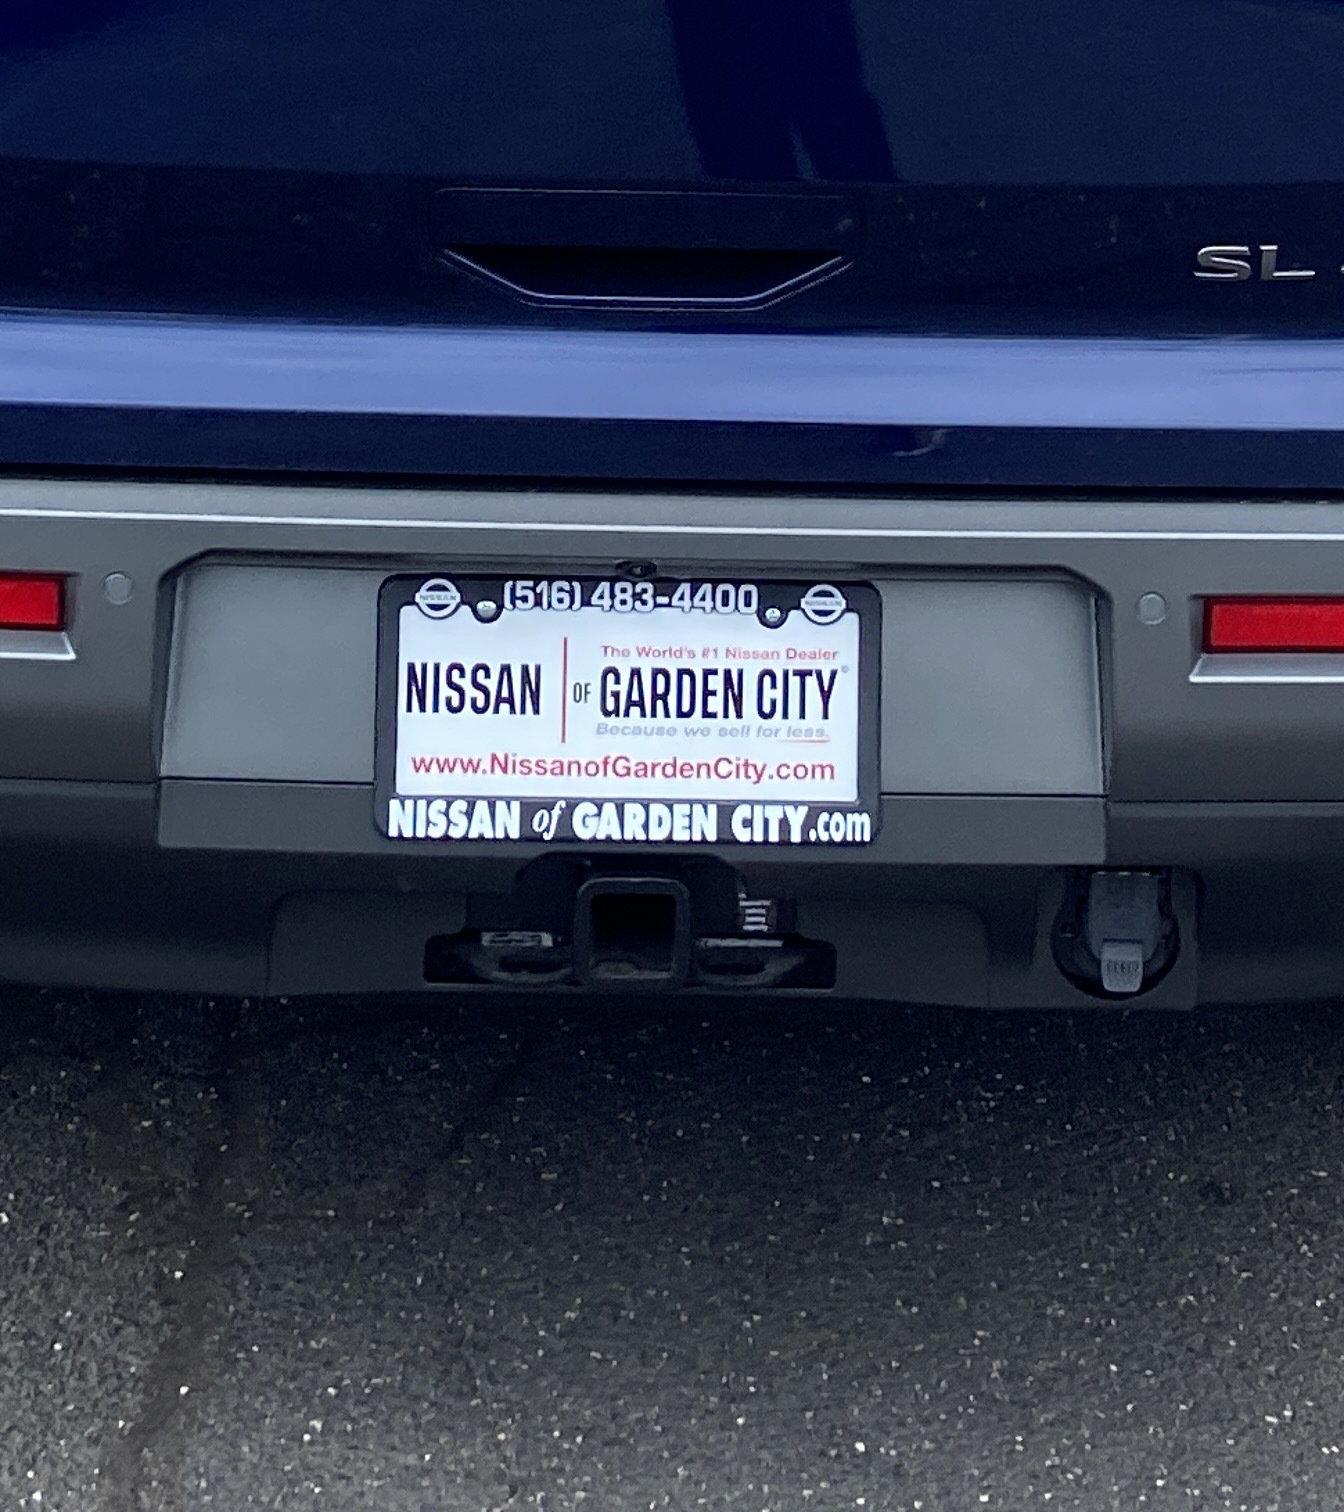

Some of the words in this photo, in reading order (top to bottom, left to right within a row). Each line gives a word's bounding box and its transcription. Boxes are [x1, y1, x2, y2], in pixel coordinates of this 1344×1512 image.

[1193, 245, 1316, 281] SL
[504, 580, 582, 611] (516)
[591, 581, 759, 616] 483-4400
[600, 644, 631, 658] The
[636, 645, 697, 660] World's
[702, 646, 719, 660] #1
[725, 646, 781, 661] Nissan
[785, 647, 839, 661] Dealer
[406, 661, 541, 716] NISSAN
[573, 682, 592, 704] OF
[600, 665, 744, 720] GARDEN
[757, 667, 838, 721] CITY
[596, 722, 678, 738] Because
[684, 725, 712, 738] we
[718, 724, 751, 738] sell
[756, 725, 782, 739] for
[411, 752, 836, 785] www.NissanofGardenCity.com
[388, 798, 521, 839] NISSAN
[531, 799, 567, 841] of
[571, 801, 718, 841] GARDEN
[730, 803, 872, 843] CITY.com
